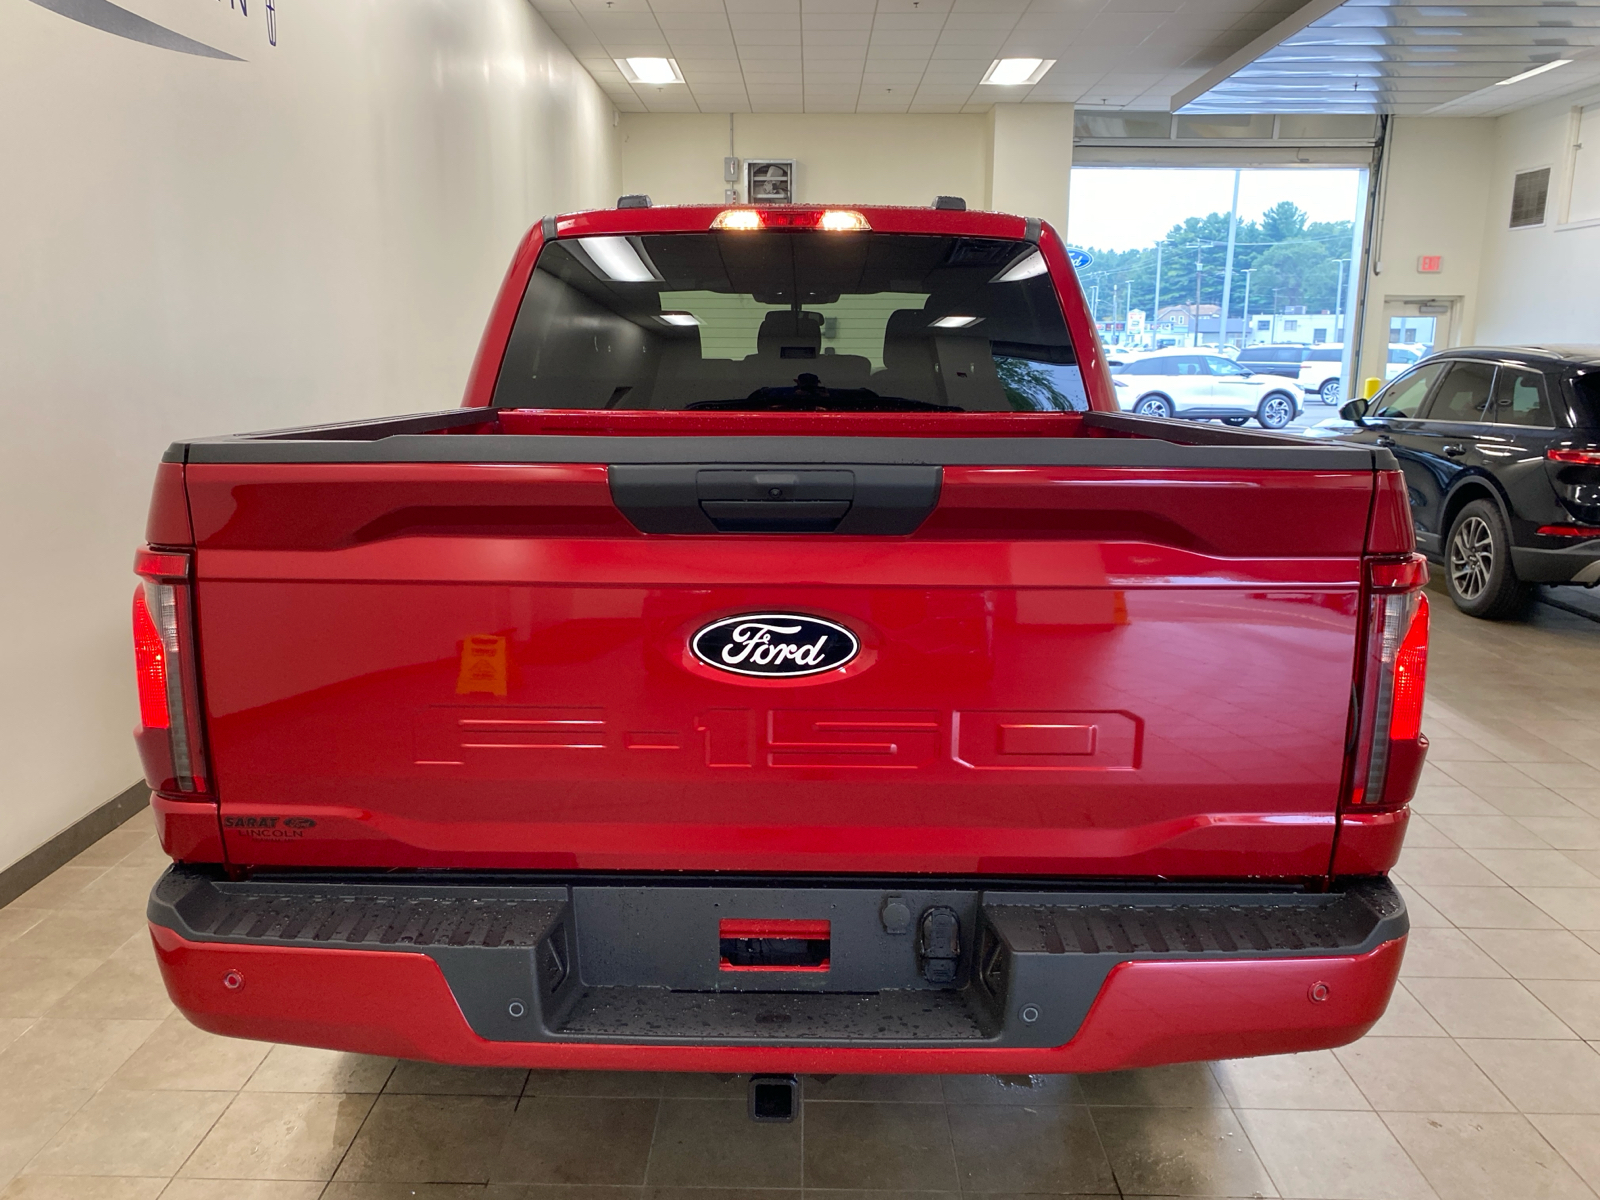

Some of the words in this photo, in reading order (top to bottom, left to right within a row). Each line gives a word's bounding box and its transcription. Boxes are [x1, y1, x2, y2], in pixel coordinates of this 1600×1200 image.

[1421, 255, 1441, 271] EXIT
[721, 623, 829, 666] Ford
[412, 704, 1144, 771] F-150
[225, 816, 280, 828] SARAT
[238, 829, 304, 838] LINCOLN
